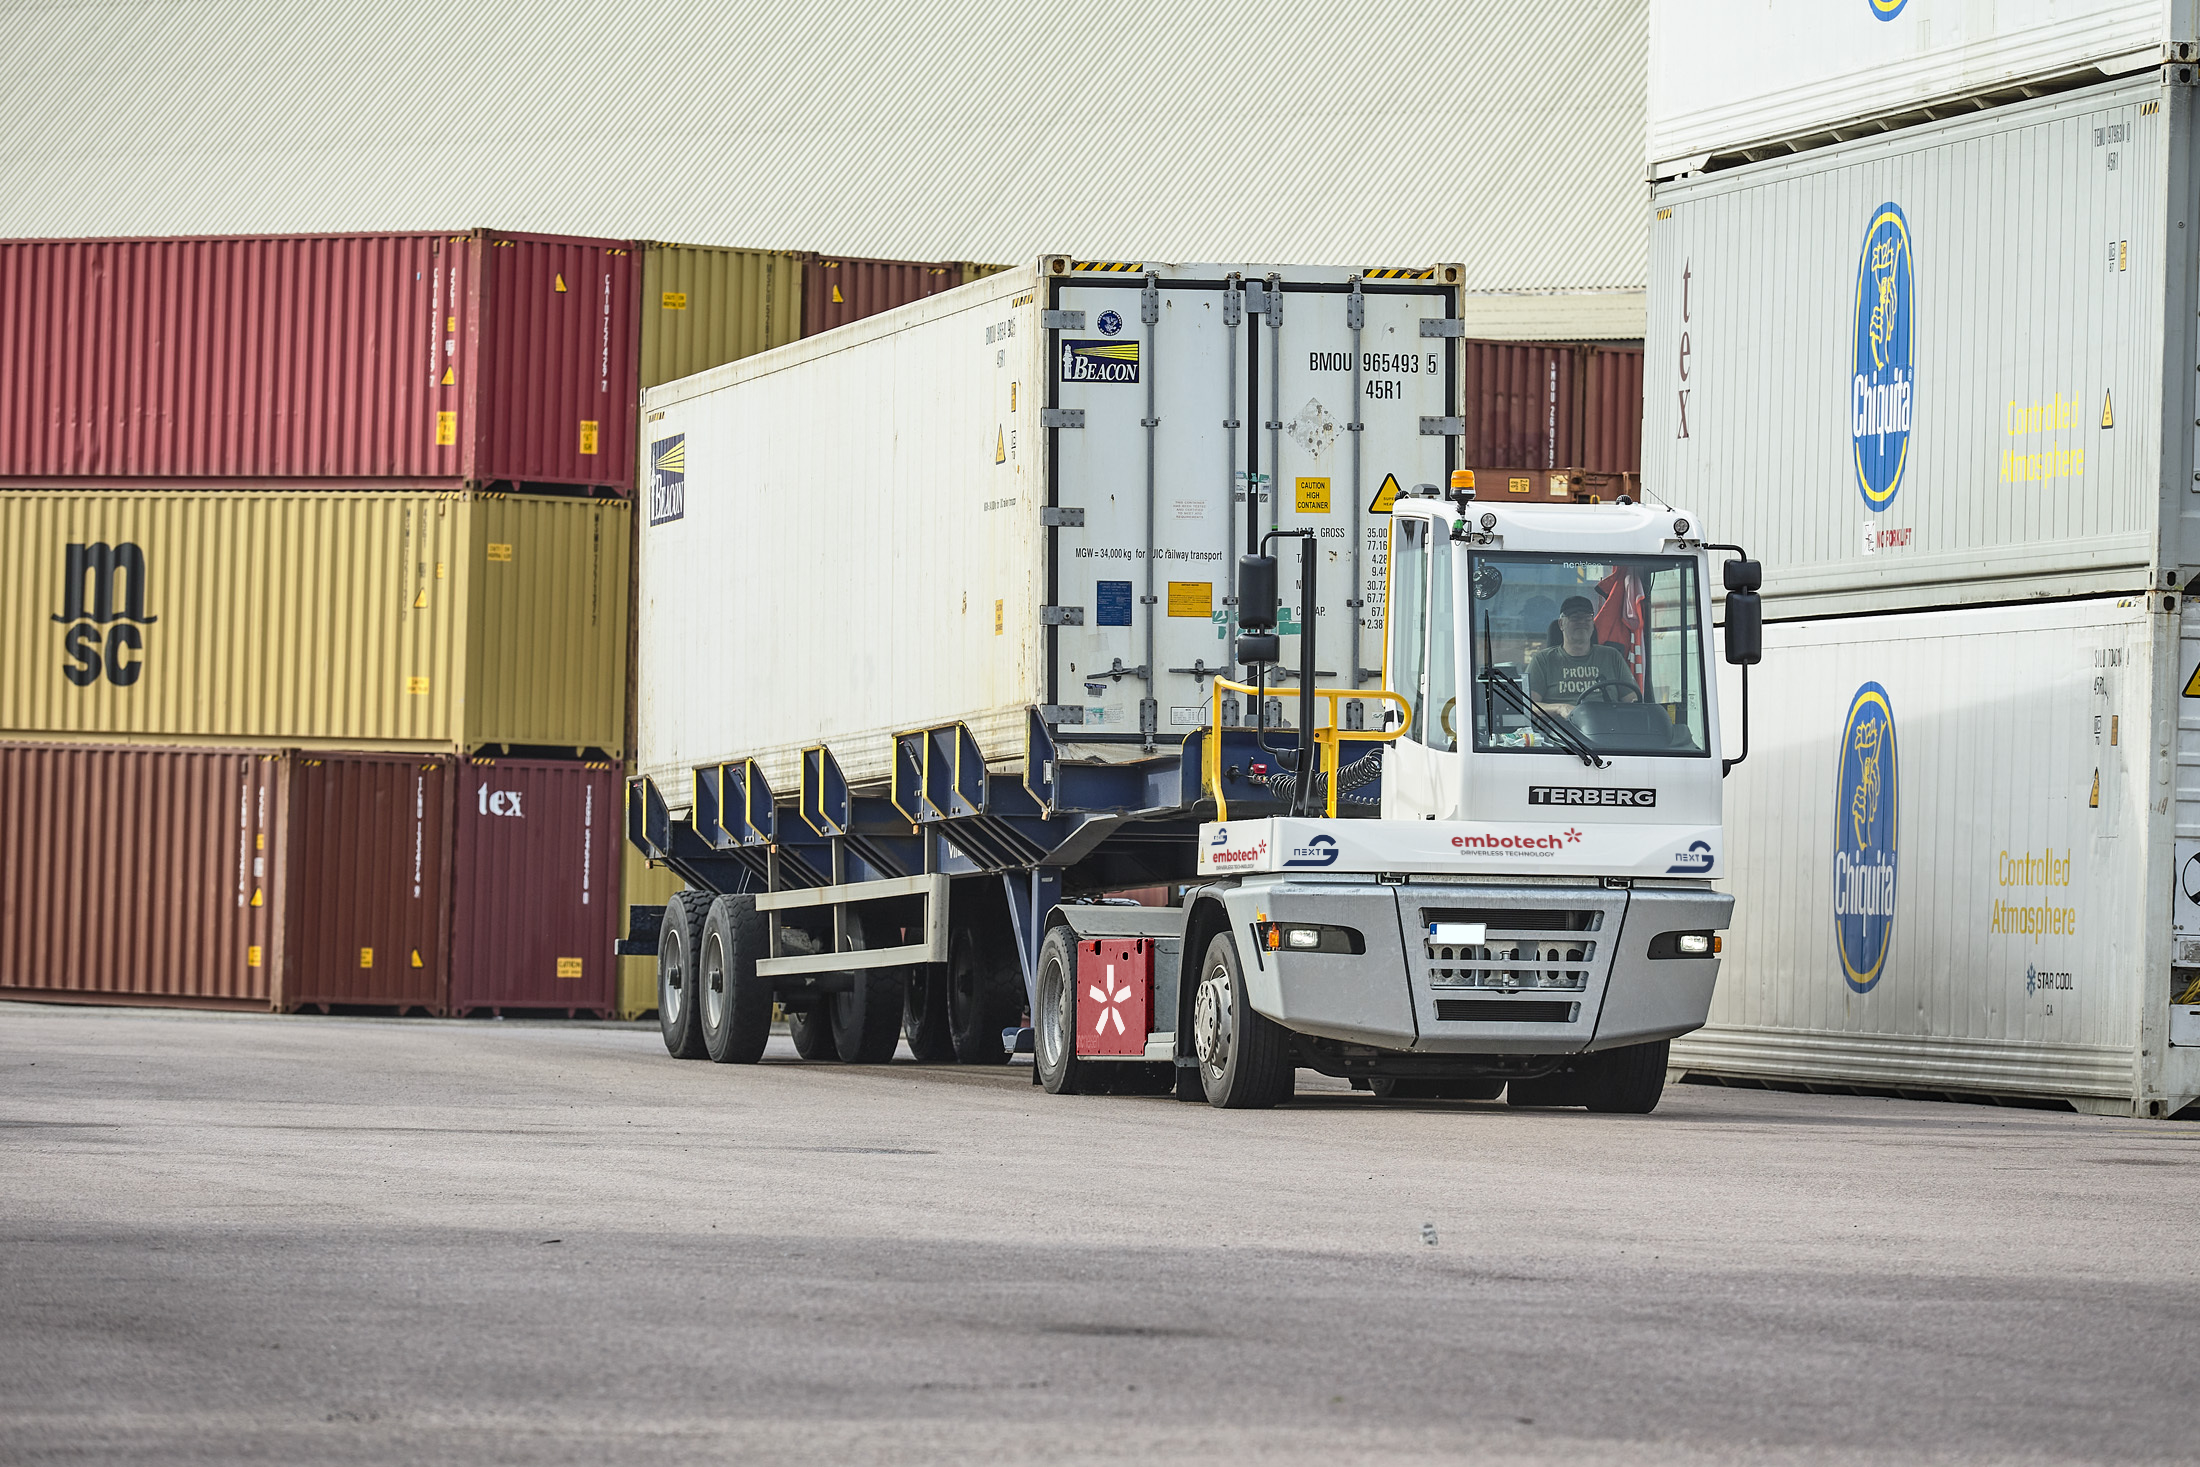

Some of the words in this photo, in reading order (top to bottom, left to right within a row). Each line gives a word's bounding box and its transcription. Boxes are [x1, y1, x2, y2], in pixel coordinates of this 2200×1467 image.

[1072, 356, 1138, 381] BEACON
[1309, 352, 1352, 372] BMOU
[1363, 353, 1419, 373] 965493
[1428, 354, 1437, 374] 5
[1366, 380, 1402, 400] 45R1
[1853, 367, 1911, 456] Chiquita
[2007, 390, 2079, 436] Controlled
[1999, 440, 2084, 490] Atmosphere
[1320, 528, 1345, 538] GROSS
[1075, 548, 1094, 558] MGW
[1100, 548, 1122, 560] 34,000
[1123, 549, 1132, 561] kg
[1136, 549, 1146, 559] for
[1164, 549, 1188, 562] railway
[1190, 550, 1222, 562] transport
[1562, 666, 1600, 679] PROUD
[1559, 681, 1600, 694] DOCK
[478, 781, 523, 817] tex
[1532, 788, 1654, 806] TERBERG
[1451, 834, 1563, 850] embotech
[1213, 846, 1258, 863] embotech
[1999, 848, 2070, 886] Controlled
[1835, 850, 1894, 938] Chiquita
[1991, 896, 2076, 945] Atmosphere
[2036, 972, 2054, 990] STAR
[2056, 972, 2074, 990] COOL
